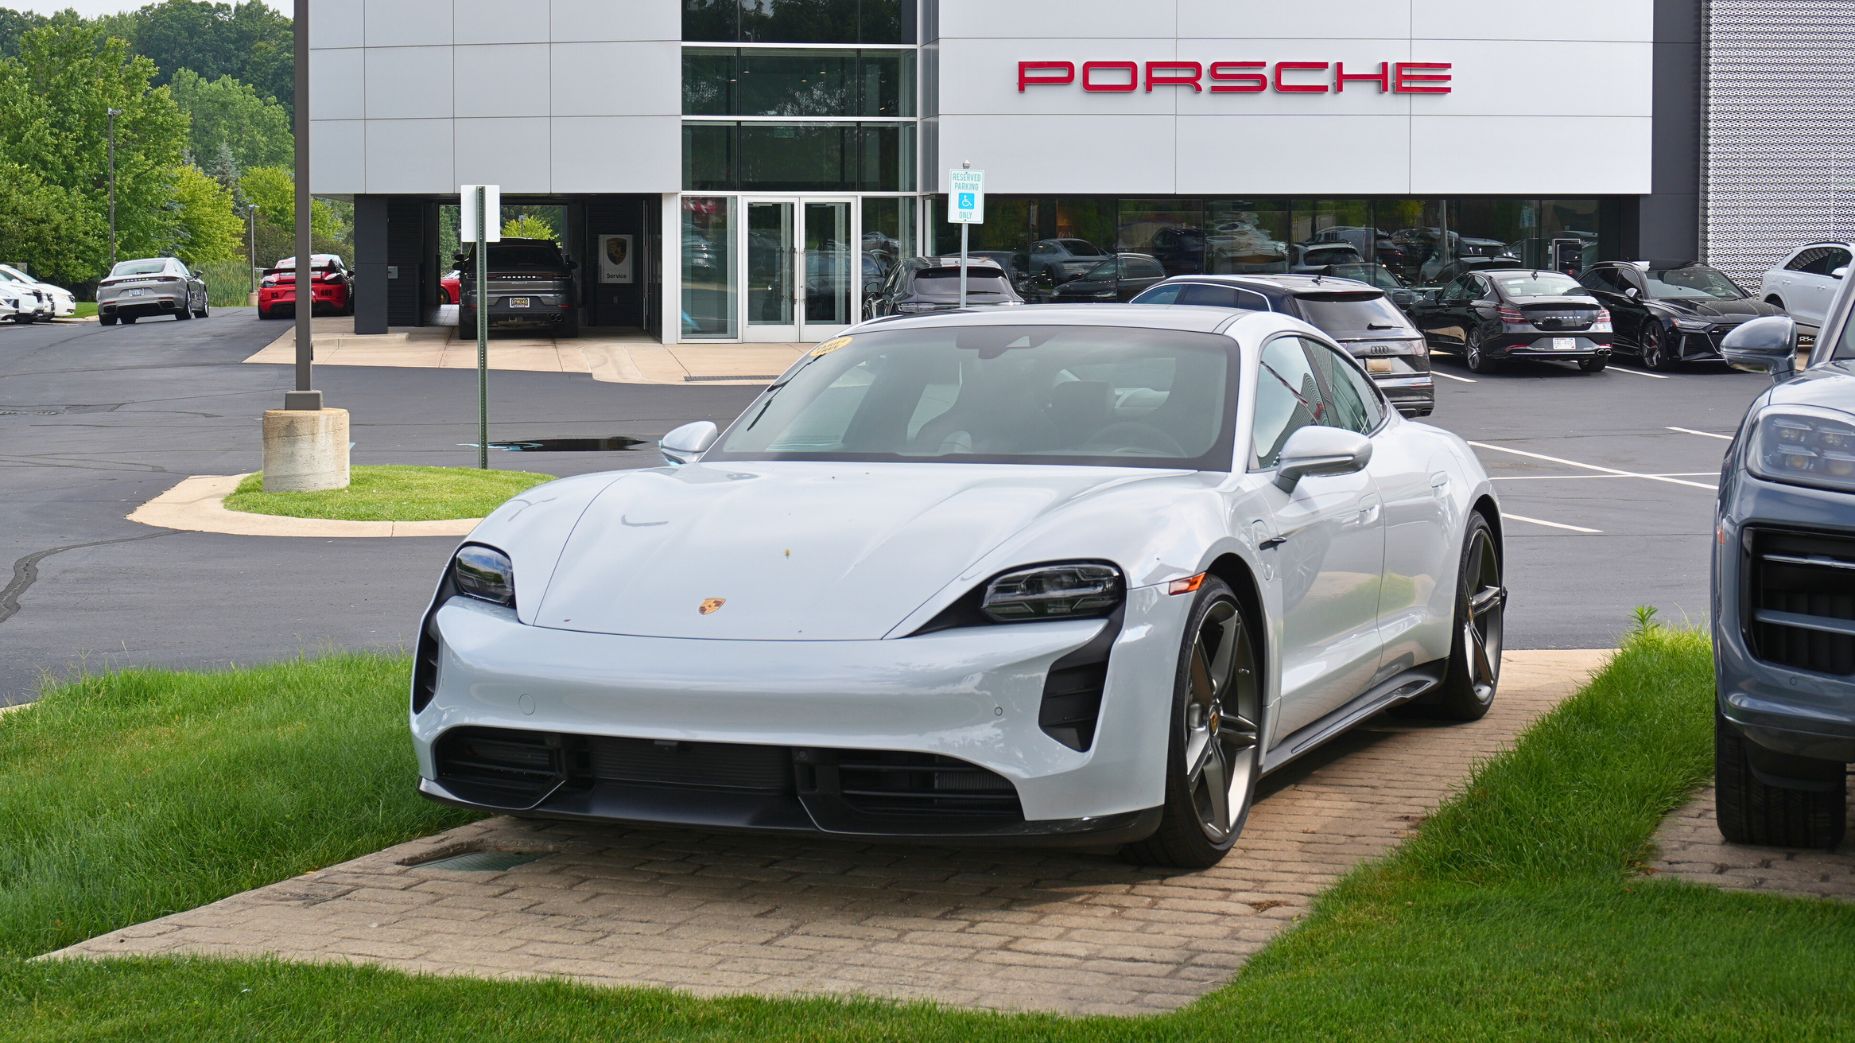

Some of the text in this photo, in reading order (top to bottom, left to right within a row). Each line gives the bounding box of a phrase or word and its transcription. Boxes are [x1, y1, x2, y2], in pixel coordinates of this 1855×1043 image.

[1017, 61, 1452, 94] PORSCHE
[952, 173, 981, 181] RESERVED
[955, 182, 978, 190] PARKING
[960, 211, 972, 219] ONLY
